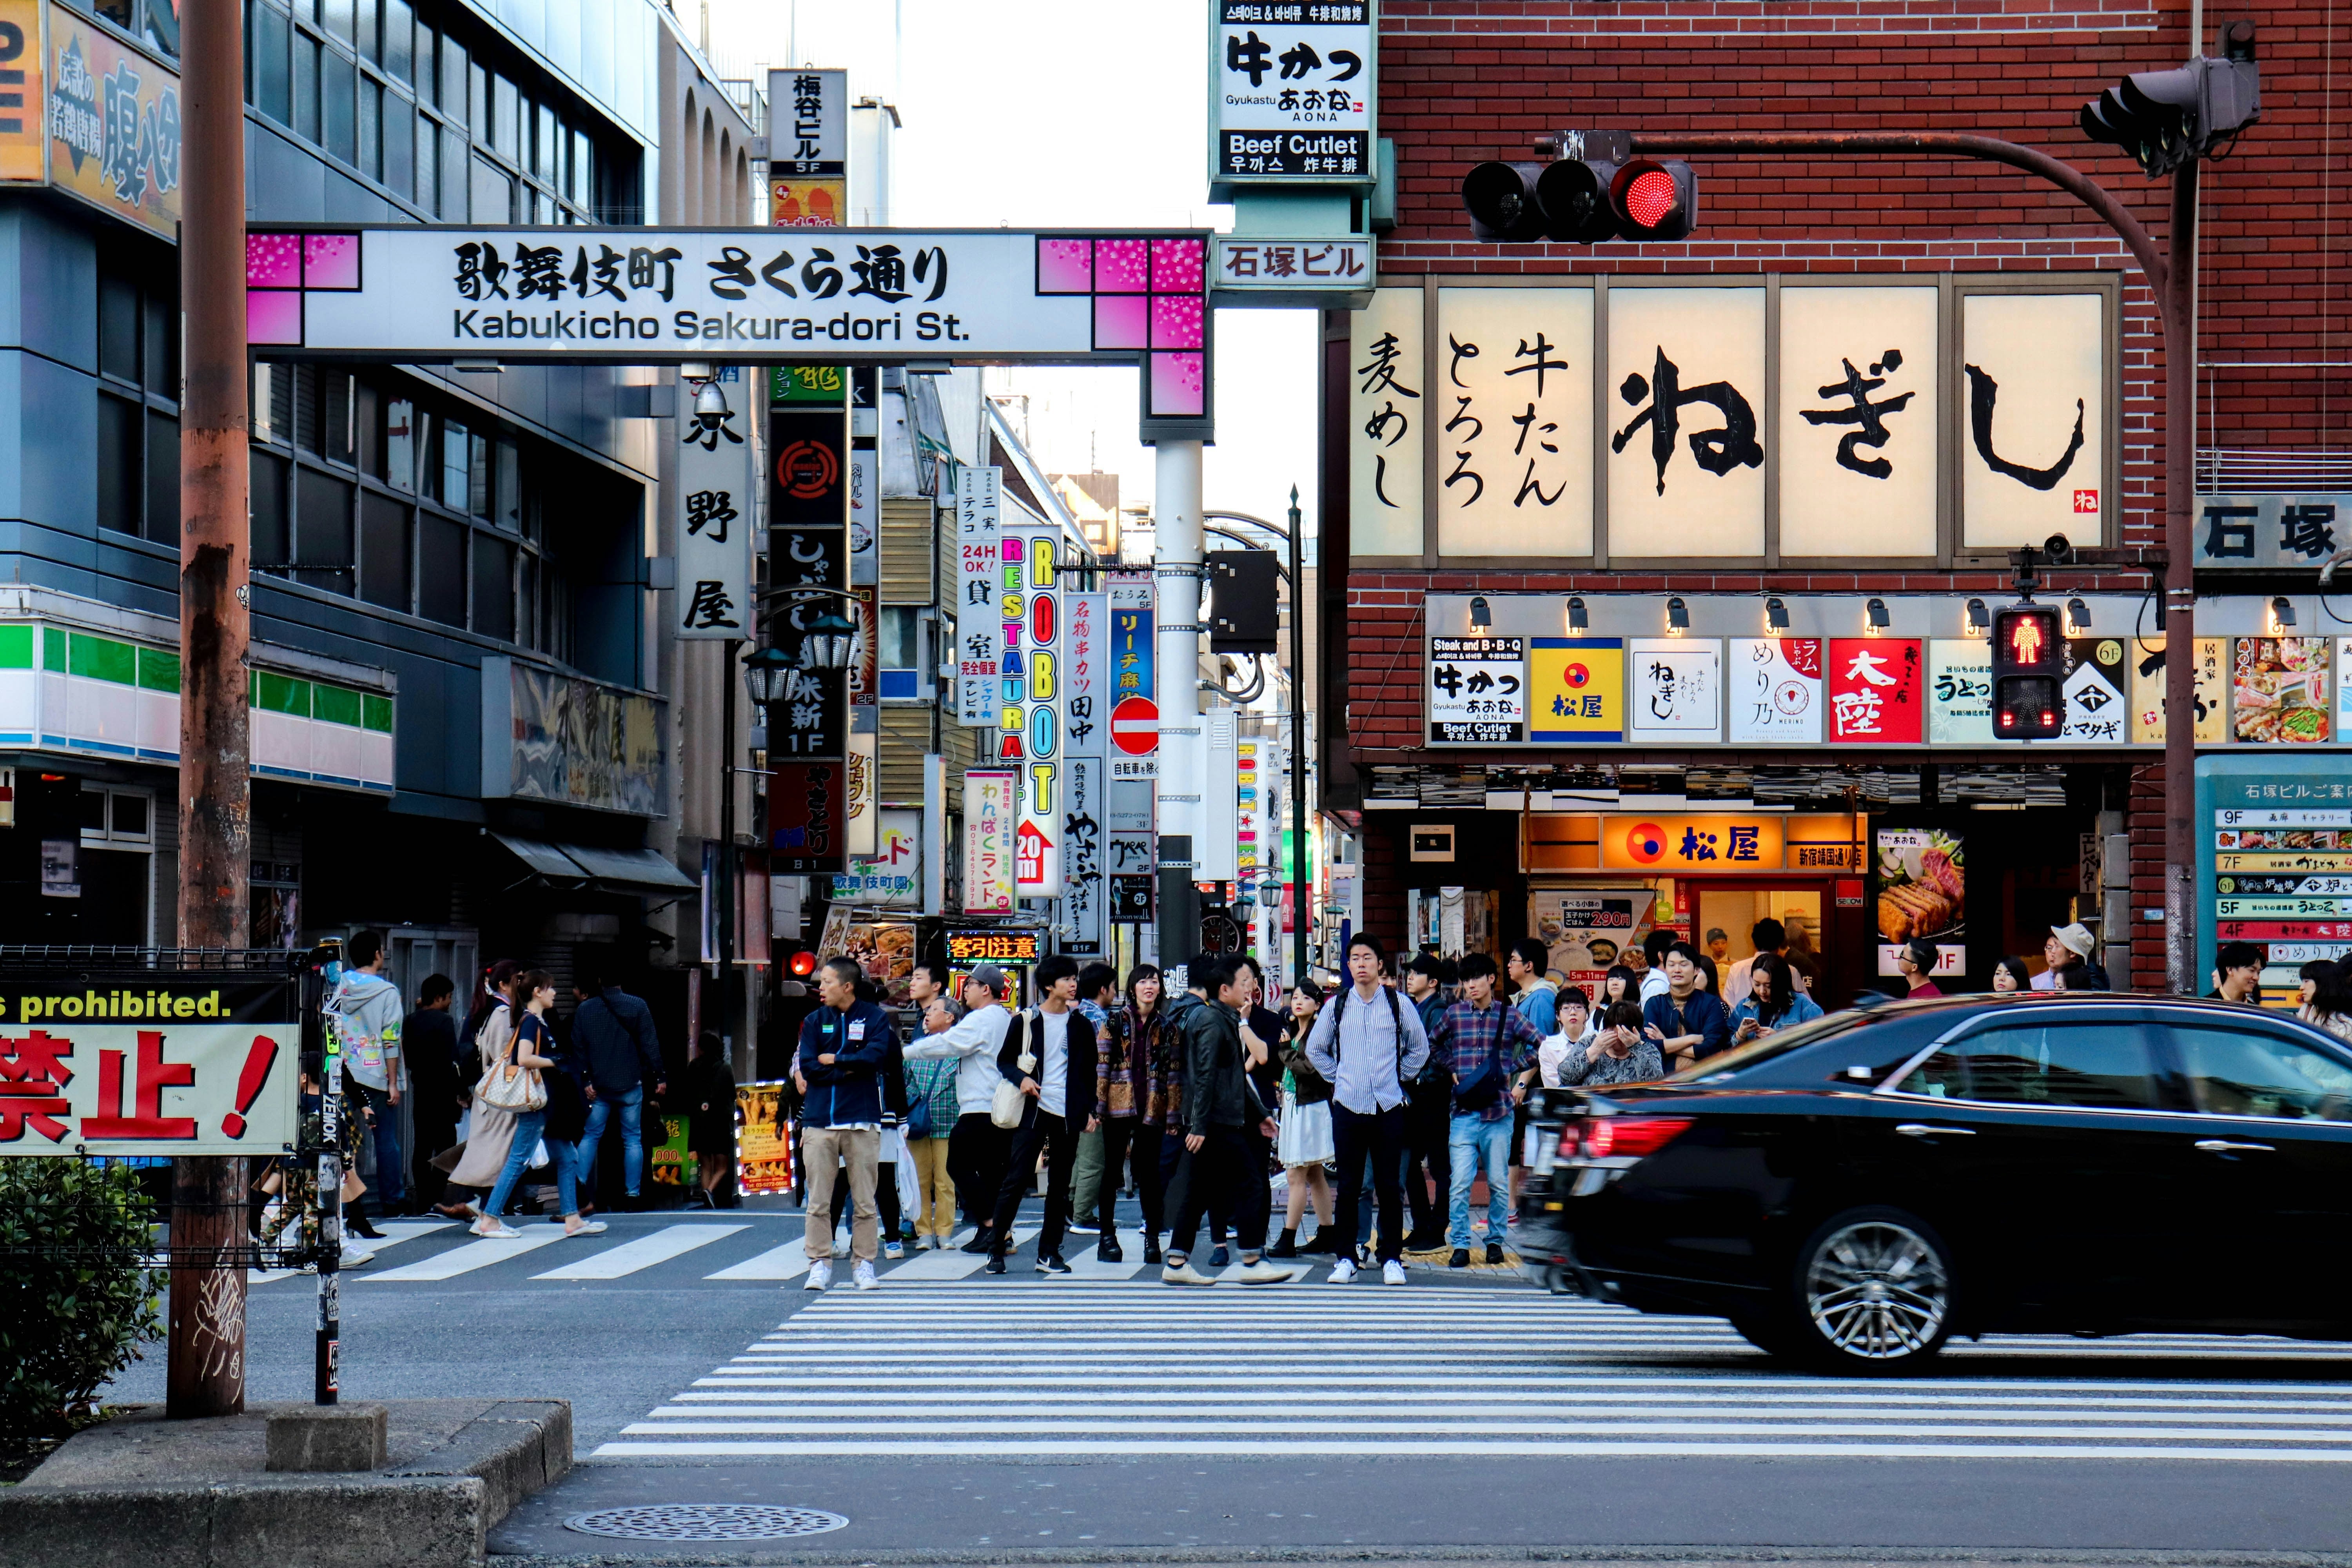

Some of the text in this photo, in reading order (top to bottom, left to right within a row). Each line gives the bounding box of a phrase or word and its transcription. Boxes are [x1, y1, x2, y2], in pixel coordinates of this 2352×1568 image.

[1226, 5, 1262, 22] 스테이크
[1264, 6, 1273, 21] &
[1274, 5, 1302, 22] 바비큐
[1227, 31, 1362, 87] 牛かつ
[1226, 95, 1276, 105] Gyukastu
[1278, 87, 1351, 111] あおな
[794, 74, 822, 160] 梅谷ビル
[1292, 112, 1338, 122] AONA
[1230, 135, 1357, 154] Beef Cutlet
[796, 162, 820, 172] 5F
[1230, 156, 1357, 173] 우까스 炸牛排
[454, 241, 947, 303] 歌舞伎町 さくら通り
[1226, 244, 1365, 277] 石塚ビル
[454, 309, 969, 341] Kabukicho Sakura-dori St.
[776, 367, 790, 398] ション
[1357, 332, 1421, 508] 麦めし
[1445, 332, 1483, 508] とろろ
[1504, 332, 1568, 508] 牛たん
[1612, 345, 2085, 497] ねぎし
[2075, 491, 2098, 510] ね
[963, 497, 976, 533] テラコ
[2204, 505, 2337, 559] 石塚
[962, 545, 996, 558] 24H
[965, 561, 994, 573] OK!
[1112, 590, 1149, 599] おうみ
[966, 579, 991, 659] 貸室
[1072, 601, 1090, 693] 名物串カツ
[1434, 639, 1461, 651] Steak
[1463, 639, 1479, 651] and
[1792, 640, 1801, 665] しゃぶ
[1802, 641, 1818, 672] ラム
[2100, 644, 2119, 660] 6F
[961, 661, 996, 675] 完全個室
[2205, 643, 2216, 680] 居酒家
[1000, 538, 1024, 815] RESTAURA
[1032, 538, 1056, 813] ROBOT
[1434, 663, 1520, 699] 牛かつ
[1750, 642, 1774, 725] めり乃
[857, 695, 874, 704] 2F
[964, 681, 977, 719] テレビ有
[981, 680, 992, 719] シャワー有
[1650, 660, 1675, 720] ねぎし
[1832, 650, 1898, 737] 大陸
[1935, 675, 1992, 701] うとっ
[1467, 699, 1514, 714] あおな
[1552, 694, 1602, 718] 松屋
[1069, 696, 1094, 746] 田中
[1443, 722, 1511, 733] Beef Cutlet
[788, 734, 824, 752] 1F
[1447, 733, 1508, 741] 우까스 炸牛排
[1114, 763, 1158, 775] 自転車を除く
[805, 765, 832, 855] やきとり
[2225, 811, 2243, 824] 9F
[2301, 813, 2345, 822] ギャラリー
[981, 783, 998, 903] わんぱくランド
[1065, 811, 1103, 889] やさいや
[1679, 826, 1760, 861] 松屋
[1894, 837, 1917, 845] あおな
[2219, 833, 2236, 847] 8F
[793, 860, 817, 869] B1
[1110, 839, 1148, 868] ウペペ
[1799, 847, 1862, 867] 新宿靖国通り店
[2082, 834, 2096, 892] エレベーター
[2223, 857, 2241, 869] 7F
[832, 875, 908, 890] 歌舞伎町園
[2220, 881, 2234, 891] 6F
[2323, 879, 2352, 892] 炉と
[1133, 909, 1151, 920] walk
[1591, 912, 1630, 926] 290円
[2220, 902, 2239, 914] 5F
[2225, 923, 2244, 937] 4F
[950, 937, 1036, 958] 客引注意
[2293, 945, 2342, 960] めり乃
[21, 990, 231, 1024] prohibited.
[322, 1095, 337, 1143] ZEMOK
